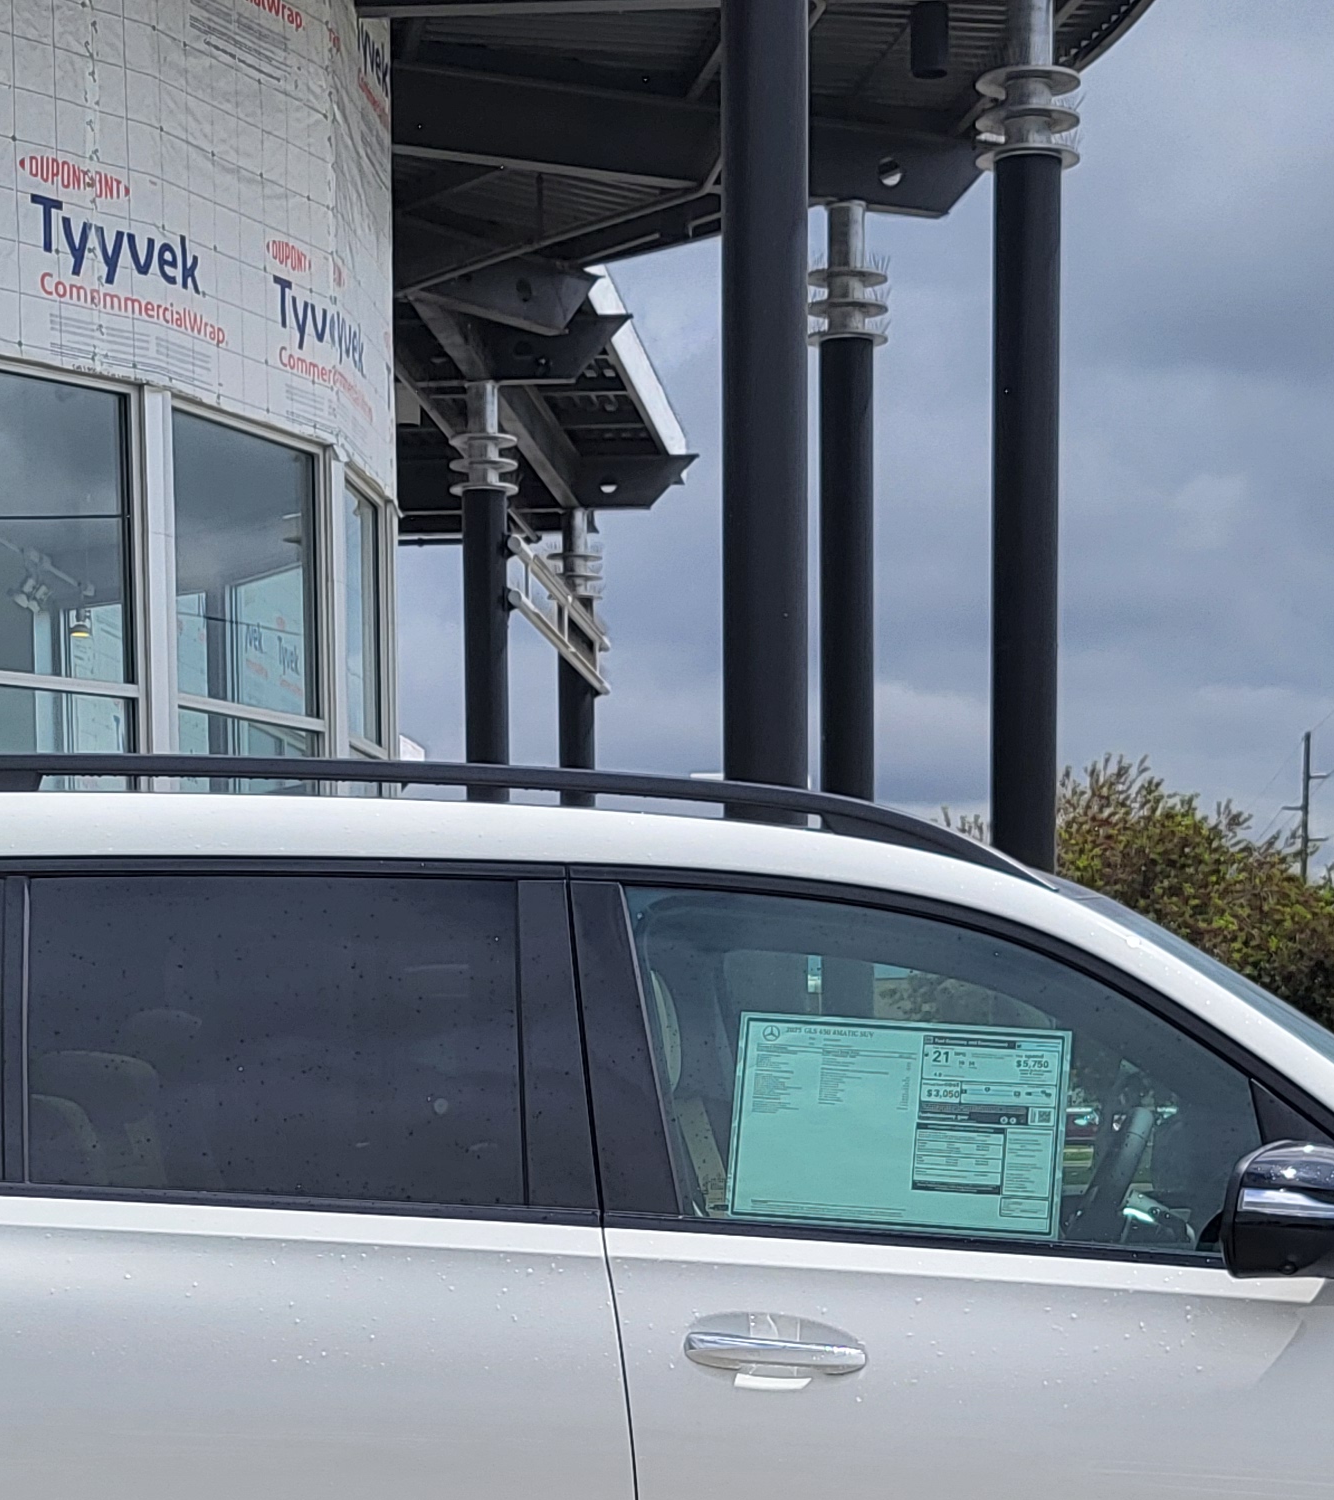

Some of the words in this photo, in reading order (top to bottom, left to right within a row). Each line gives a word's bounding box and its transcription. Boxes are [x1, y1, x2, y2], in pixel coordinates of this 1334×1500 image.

[272, 240, 307, 272] DUPONT
[804, 1027, 818, 1035] GLS
[860, 1031, 874, 1039] SUV
[932, 1050, 950, 1063] 21
[1016, 1060, 1049, 1069] $5,750
[926, 1089, 960, 1099] $3,050
